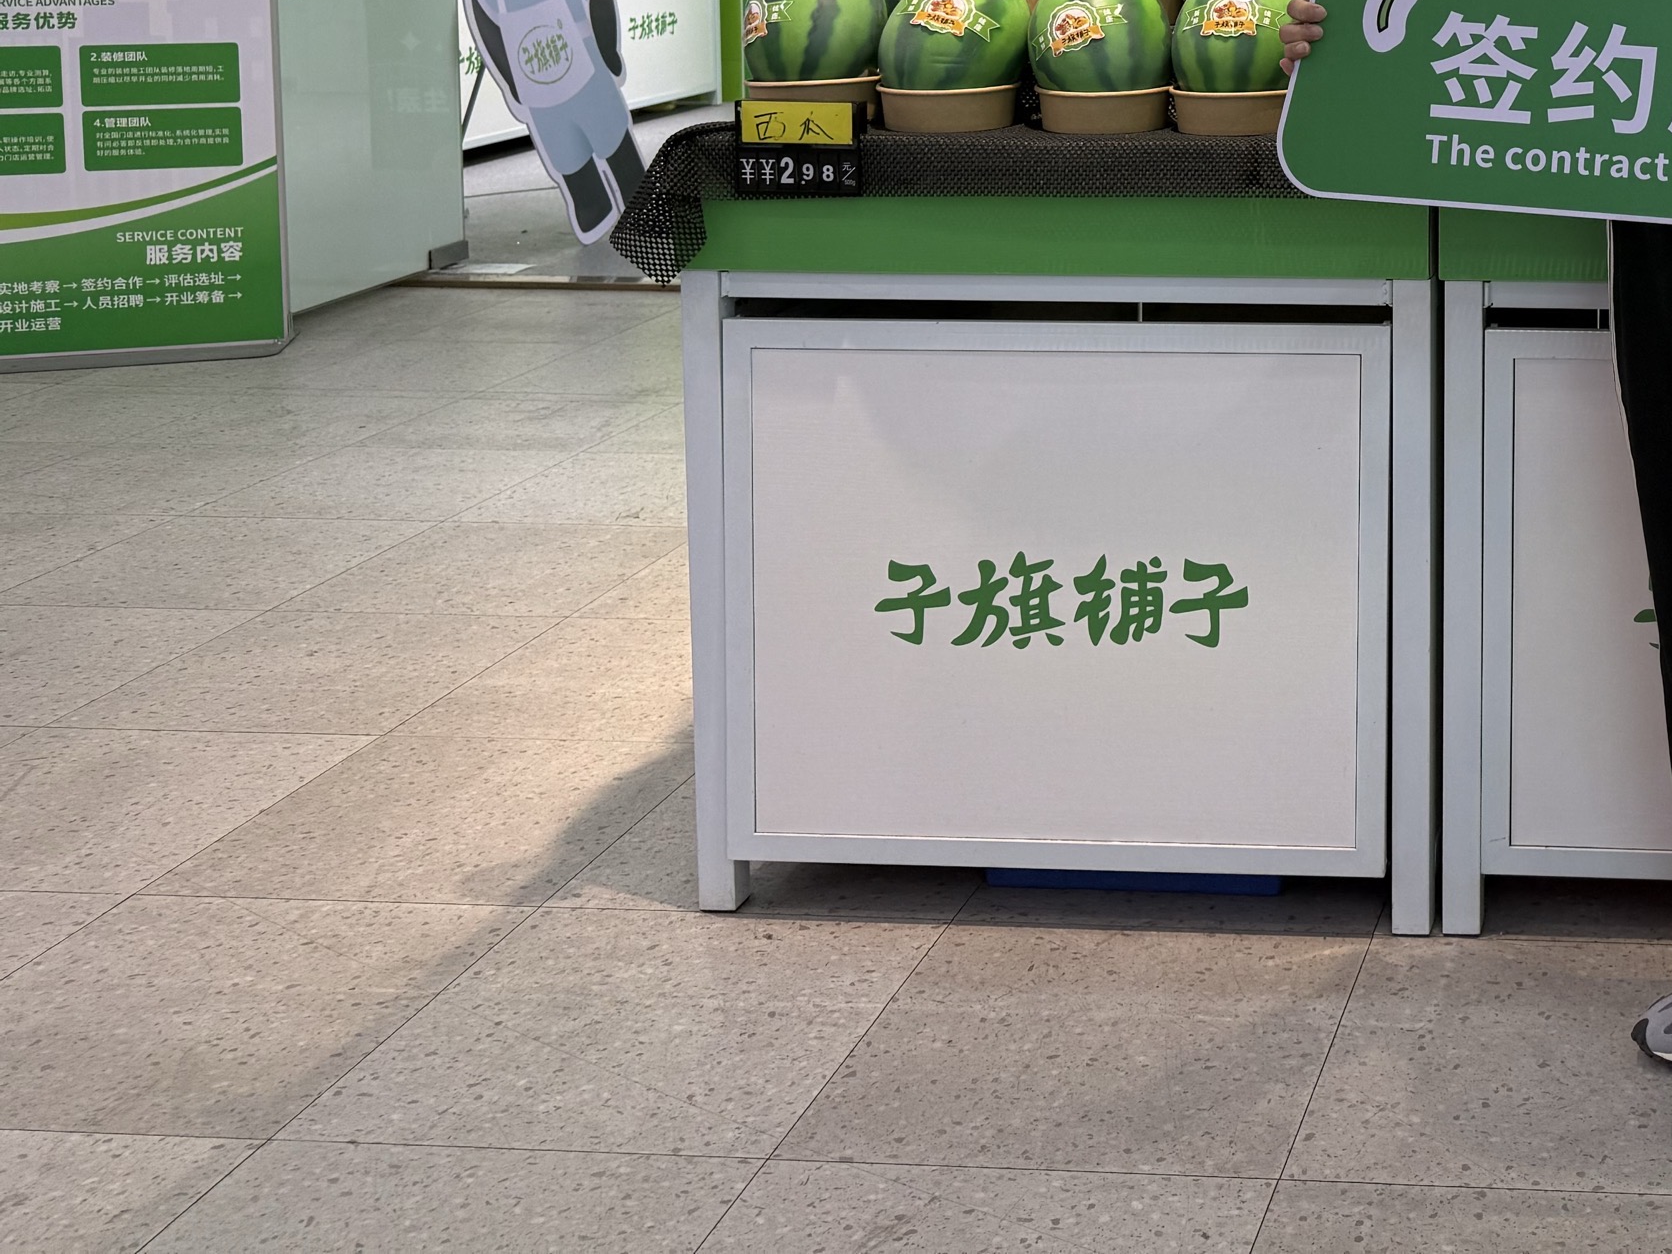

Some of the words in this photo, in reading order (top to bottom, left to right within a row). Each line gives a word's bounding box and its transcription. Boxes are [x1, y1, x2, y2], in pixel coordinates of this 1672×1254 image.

[627, 11, 678, 41] 子旗铺子
[90, 51, 148, 63] 2.装修团队
[522, 33, 569, 75] 子旗铺子
[93, 117, 152, 128] 4.管理团队
[753, 110, 834, 141] 西瓜
[1426, 133, 1496, 167] The
[1504, 147, 1669, 183] contract
[116, 230, 175, 243] SERVICE
[177, 227, 244, 240] CONTENT
[145, 242, 243, 265] 服务内容
[0, 280, 61, 295] 实地考察
[81, 276, 144, 291] 签约合作
[164, 272, 225, 288] 评估选址
[0, 300, 62, 314] 设计施工
[82, 295, 144, 310] 人员招聘
[165, 291, 225, 306] 开业筹备
[0, 317, 62, 333] 开业运营
[874, 550, 1250, 650] 子旗铺子
